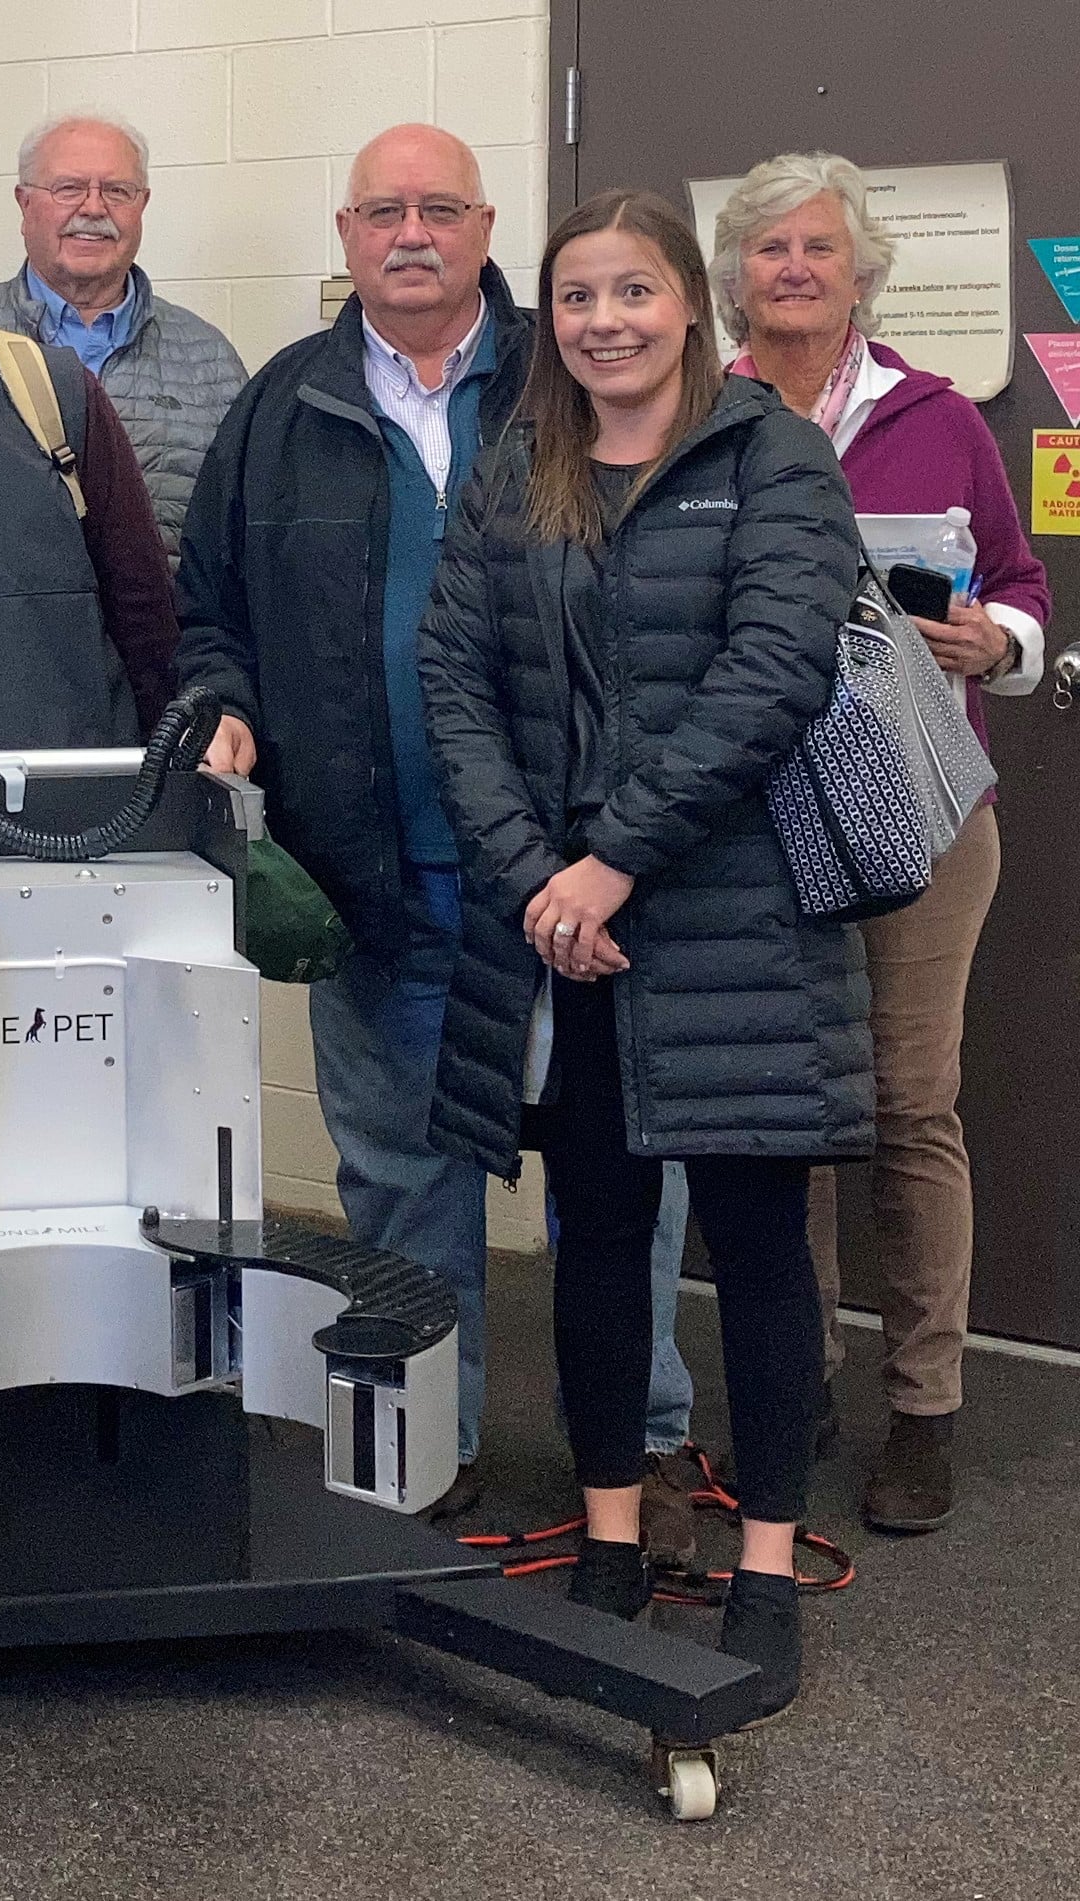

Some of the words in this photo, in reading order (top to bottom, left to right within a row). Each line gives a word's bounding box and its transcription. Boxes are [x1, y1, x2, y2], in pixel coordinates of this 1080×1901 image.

[980, 227, 1000, 235] blood
[922, 284, 944, 292] before
[959, 282, 1001, 291] radiographic
[1049, 435, 1080, 446] CAUT
[1042, 500, 1080, 509] RADIOA
[54, 1013, 113, 1043] PET
[57, 1225, 108, 1234] MILE
